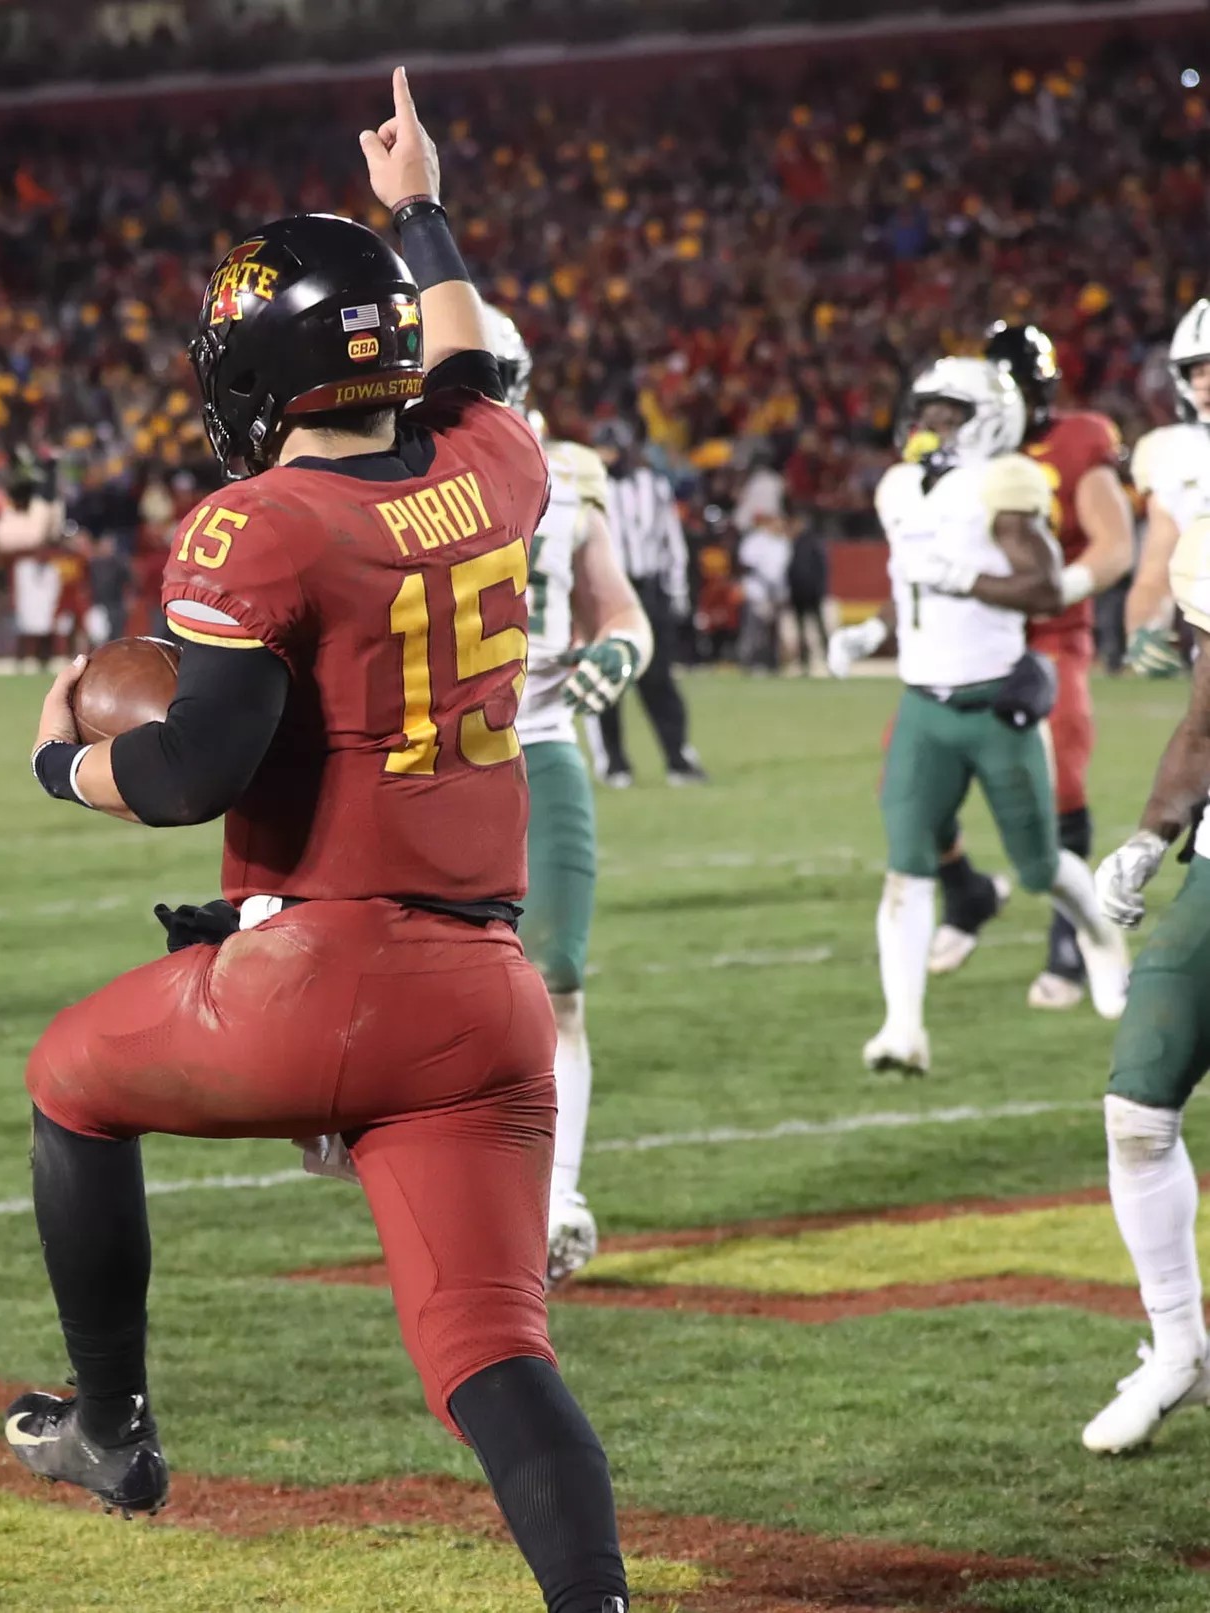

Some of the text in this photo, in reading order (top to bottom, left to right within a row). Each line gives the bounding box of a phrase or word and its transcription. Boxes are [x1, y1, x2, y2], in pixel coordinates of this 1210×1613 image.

[350, 341, 377, 357] CBA
[335, 382, 385, 404] IOWA
[176, 504, 250, 570] 15
[375, 471, 492, 557] PURDY
[383, 536, 528, 776] 15
